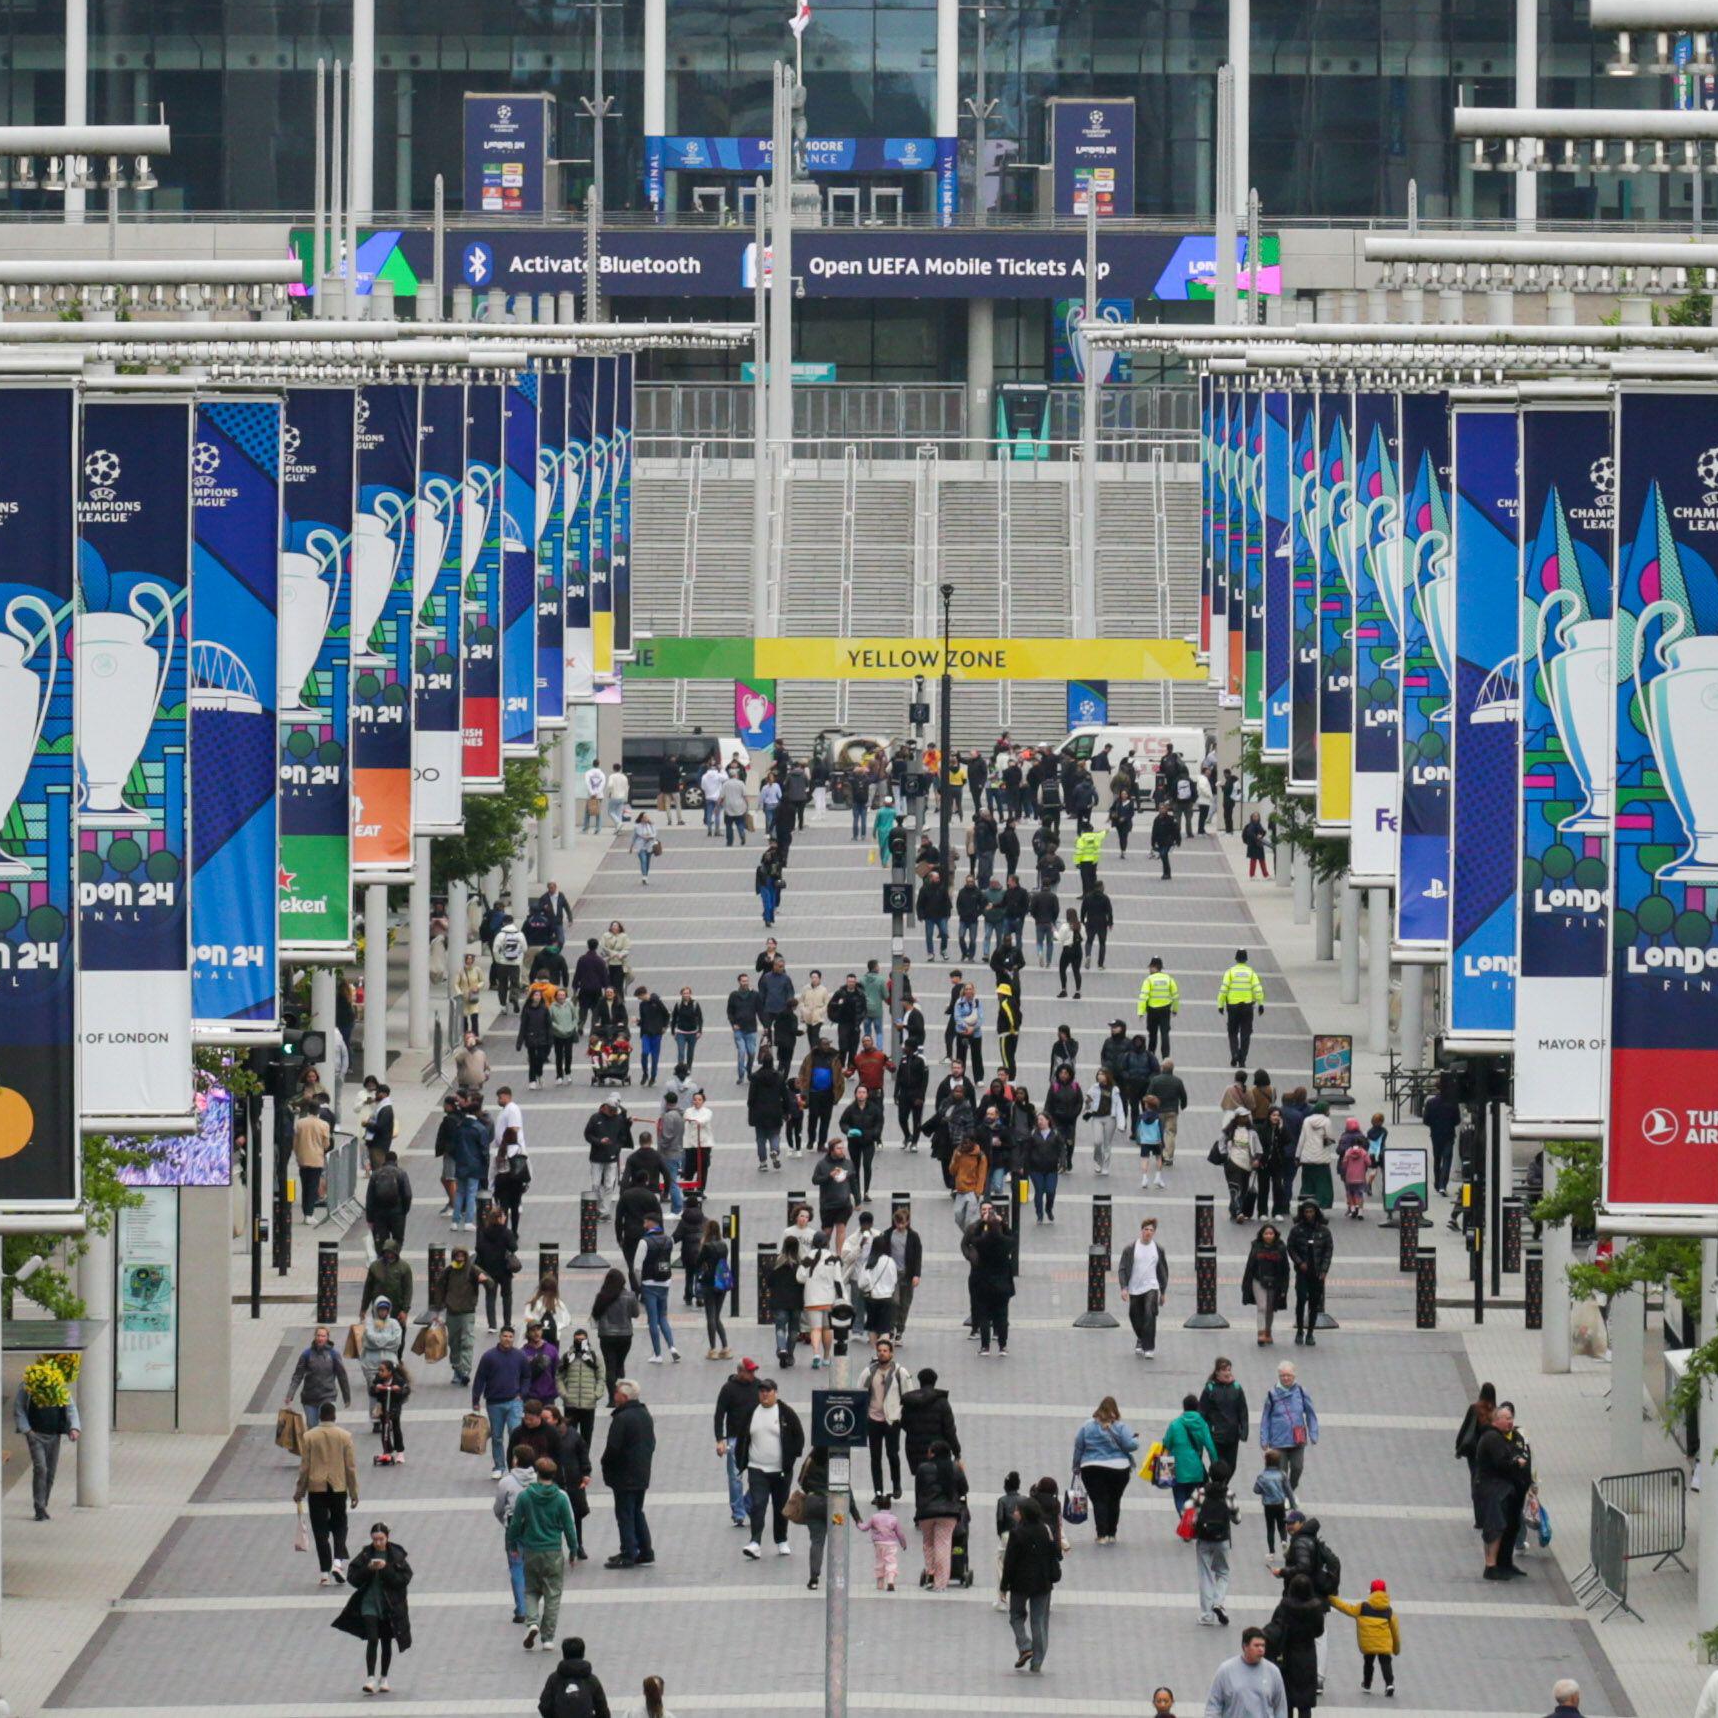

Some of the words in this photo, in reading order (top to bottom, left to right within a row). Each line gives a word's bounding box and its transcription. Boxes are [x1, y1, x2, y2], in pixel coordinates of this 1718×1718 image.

[600, 255, 701, 274] Bluetooth
[809, 257, 862, 278] Open
[868, 258, 919, 275] UEFA
[925, 256, 991, 276] Mobile
[996, 257, 1066, 277] Tickets
[1071, 258, 1110, 279] Ap
[284, 465, 317, 474] PIONS
[192, 488, 238, 497] MPIONS
[77, 501, 141, 511] HAMPIONS
[191, 498, 226, 506] EAGUE
[78, 512, 128, 522] LEAGUE
[1570, 508, 1615, 518] CHAMP
[1583, 520, 1615, 529] LEAG
[471, 644, 492, 659] 24
[848, 650, 939, 668] YELLOW
[946, 650, 1007, 668] ZONE
[428, 673, 452, 690] 24
[507, 697, 528, 712] 24
[377, 705, 403, 723] 24
[311, 765, 340, 784] 24
[354, 825, 381, 837] EAT
[138, 882, 174, 906] 24
[280, 896, 327, 914] eken
[80, 911, 140, 922] INAL
[1566, 918, 1606, 928] FIN
[17, 943, 59, 970] 24
[232, 945, 264, 967] 24
[193, 970, 235, 980] NAL
[86, 1033, 104, 1044] OF
[108, 1032, 169, 1044] LONDON
[1538, 1039, 1586, 1050] MAYOR
